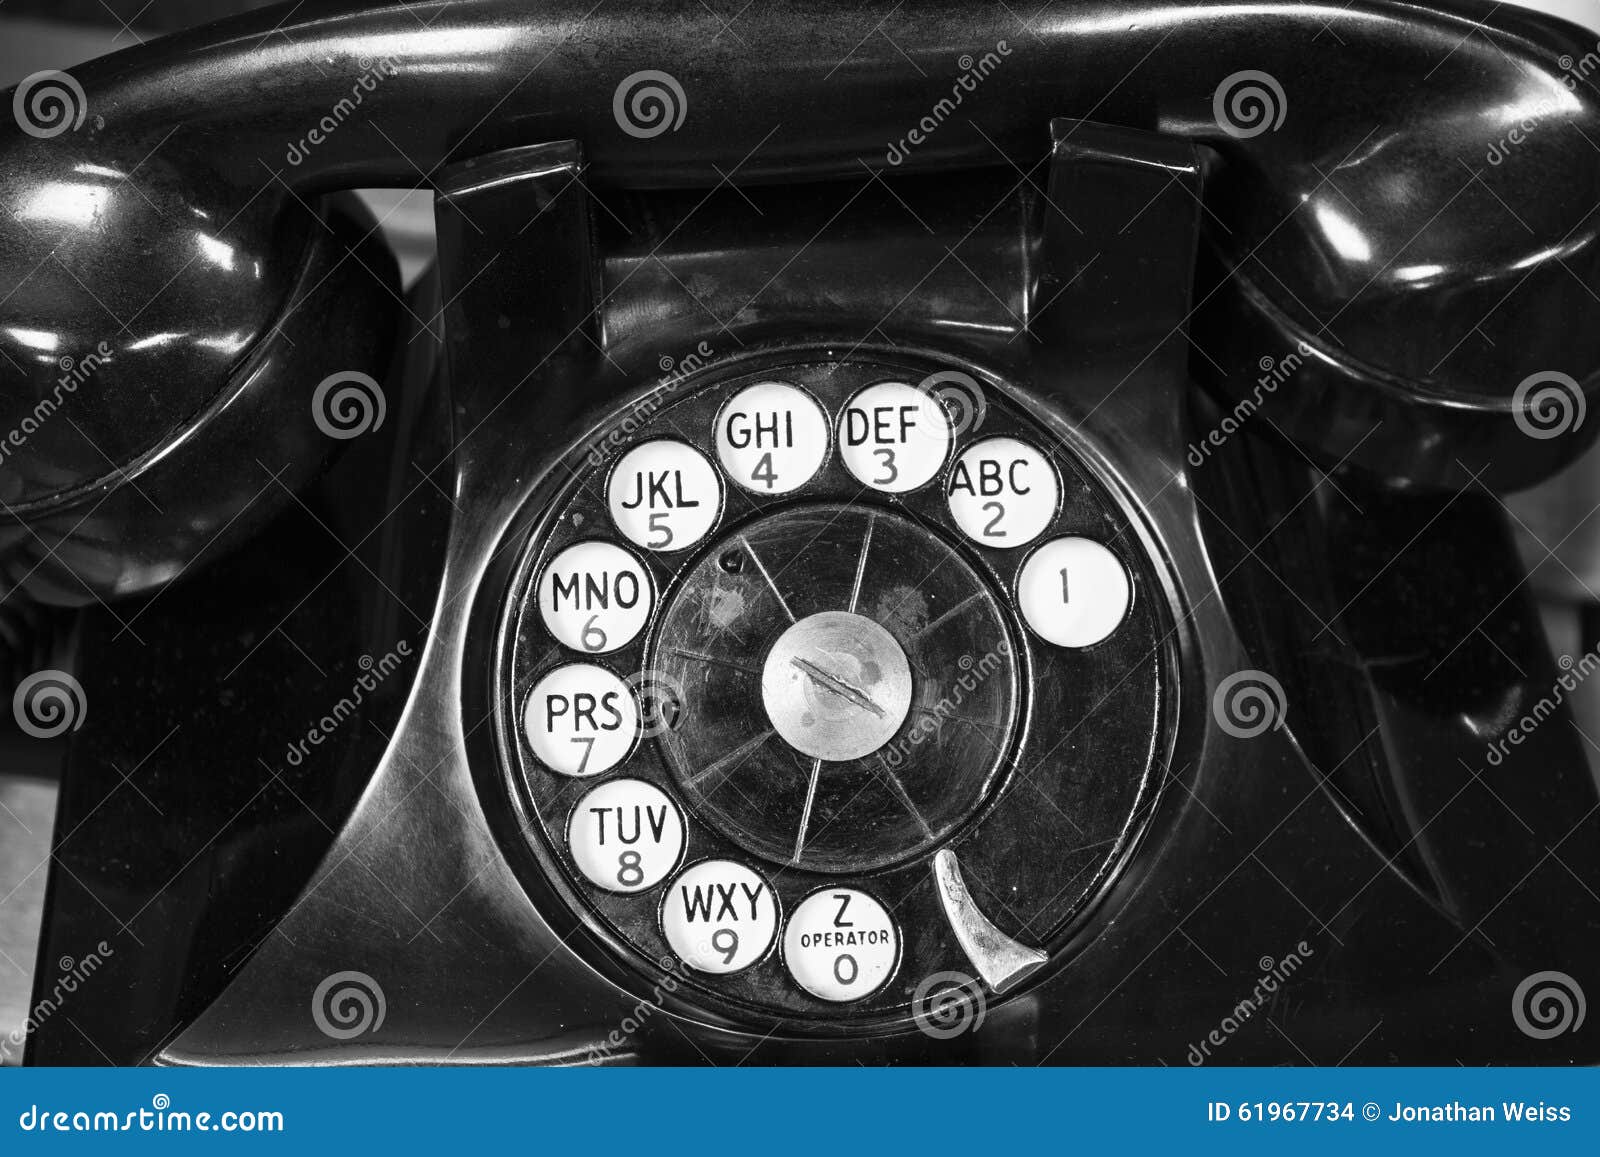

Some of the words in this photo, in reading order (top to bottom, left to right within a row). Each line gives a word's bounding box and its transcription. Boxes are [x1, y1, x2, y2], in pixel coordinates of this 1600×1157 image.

[725, 410, 793, 450] GHI
[846, 405, 919, 447] DEF
[750, 452, 779, 489] 4
[872, 448, 898, 485] 3
[948, 458, 1031, 497] ABC
[620, 469, 700, 510] JKL
[646, 512, 674, 549] 5
[982, 501, 1007, 537] 2
[552, 570, 640, 613] MNO
[581, 614, 608, 652] 6
[546, 691, 623, 733] PRS
[570, 737, 596, 774] 7
[589, 804, 668, 846] TUV
[616, 850, 645, 887] 8
[681, 882, 764, 923] WXY
[832, 894, 854, 929] Z
[711, 928, 739, 965] 9
[800, 929, 889, 948] OPERATOR
[833, 953, 859, 986] 0
